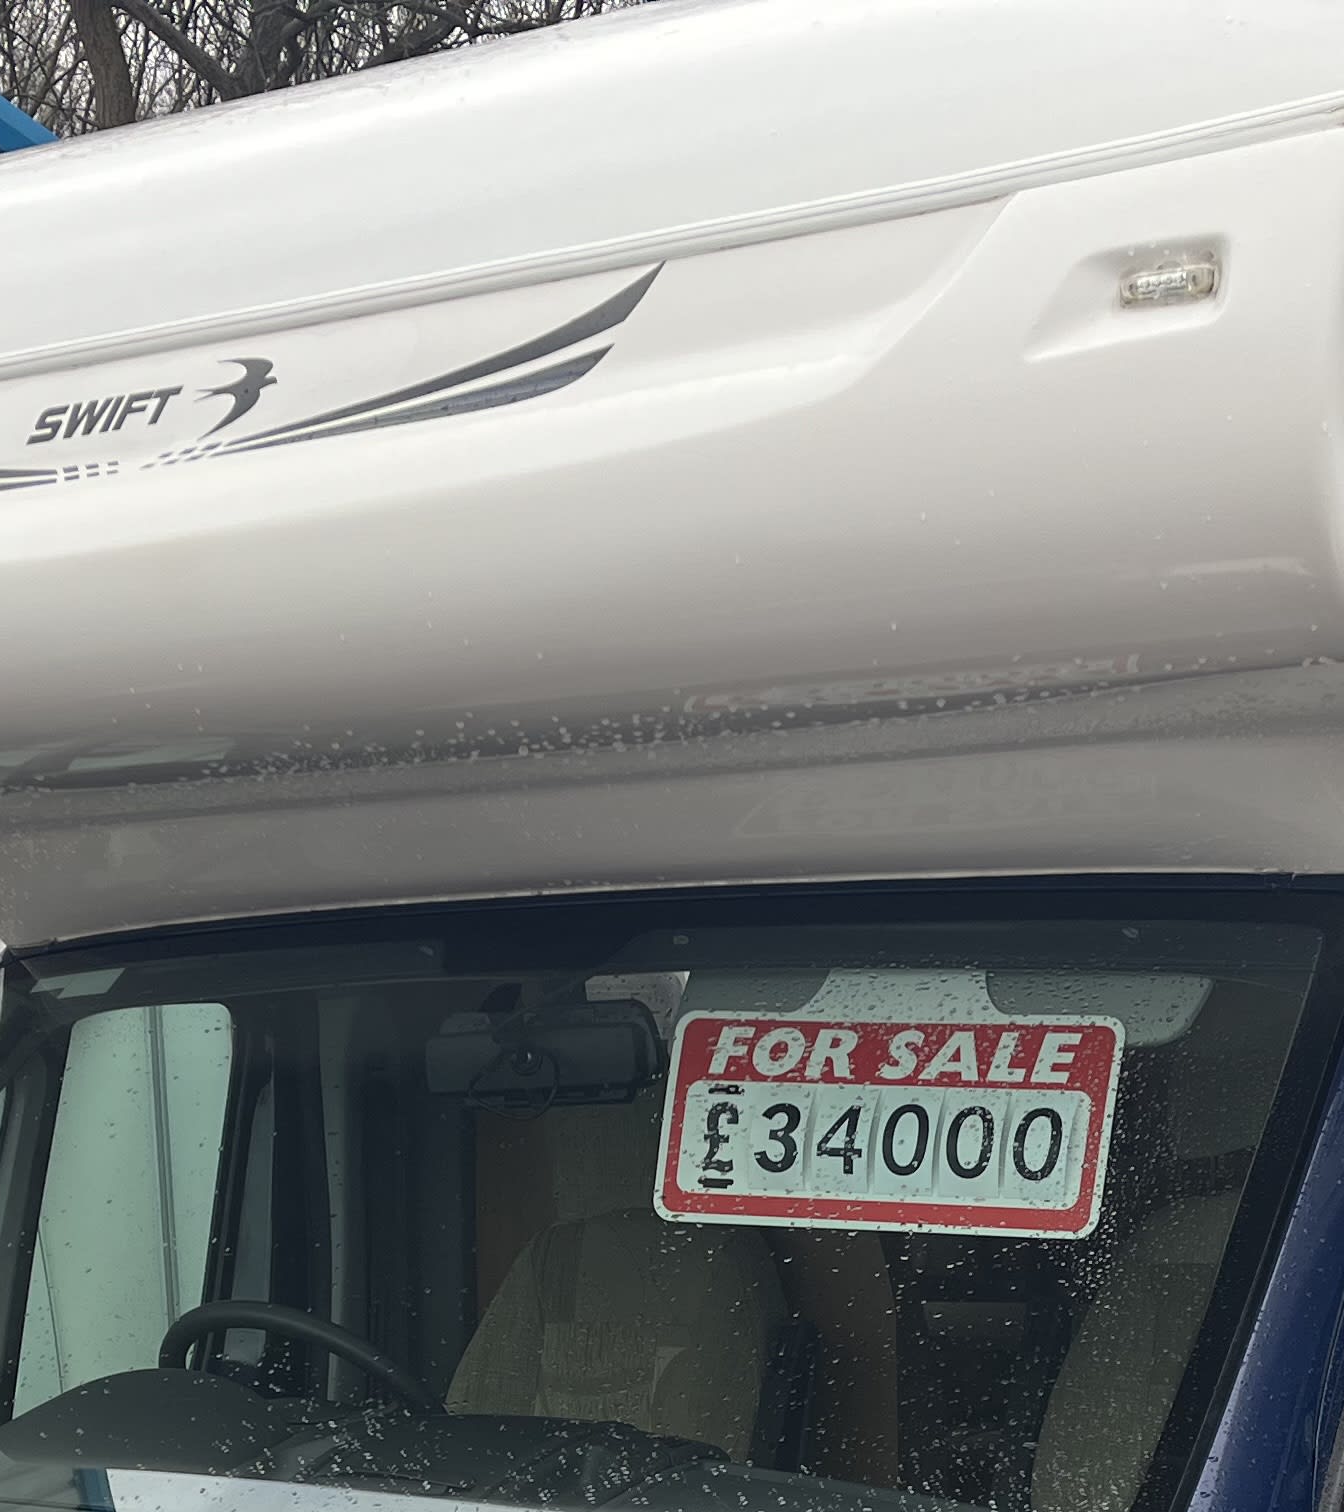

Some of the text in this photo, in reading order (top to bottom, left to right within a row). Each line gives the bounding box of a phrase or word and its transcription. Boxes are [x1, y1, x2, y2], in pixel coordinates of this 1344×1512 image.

[26, 386, 183, 445] SWIFT
[707, 1026, 1081, 1084] FOR SALE
[702, 1100, 1063, 1183] £34000
